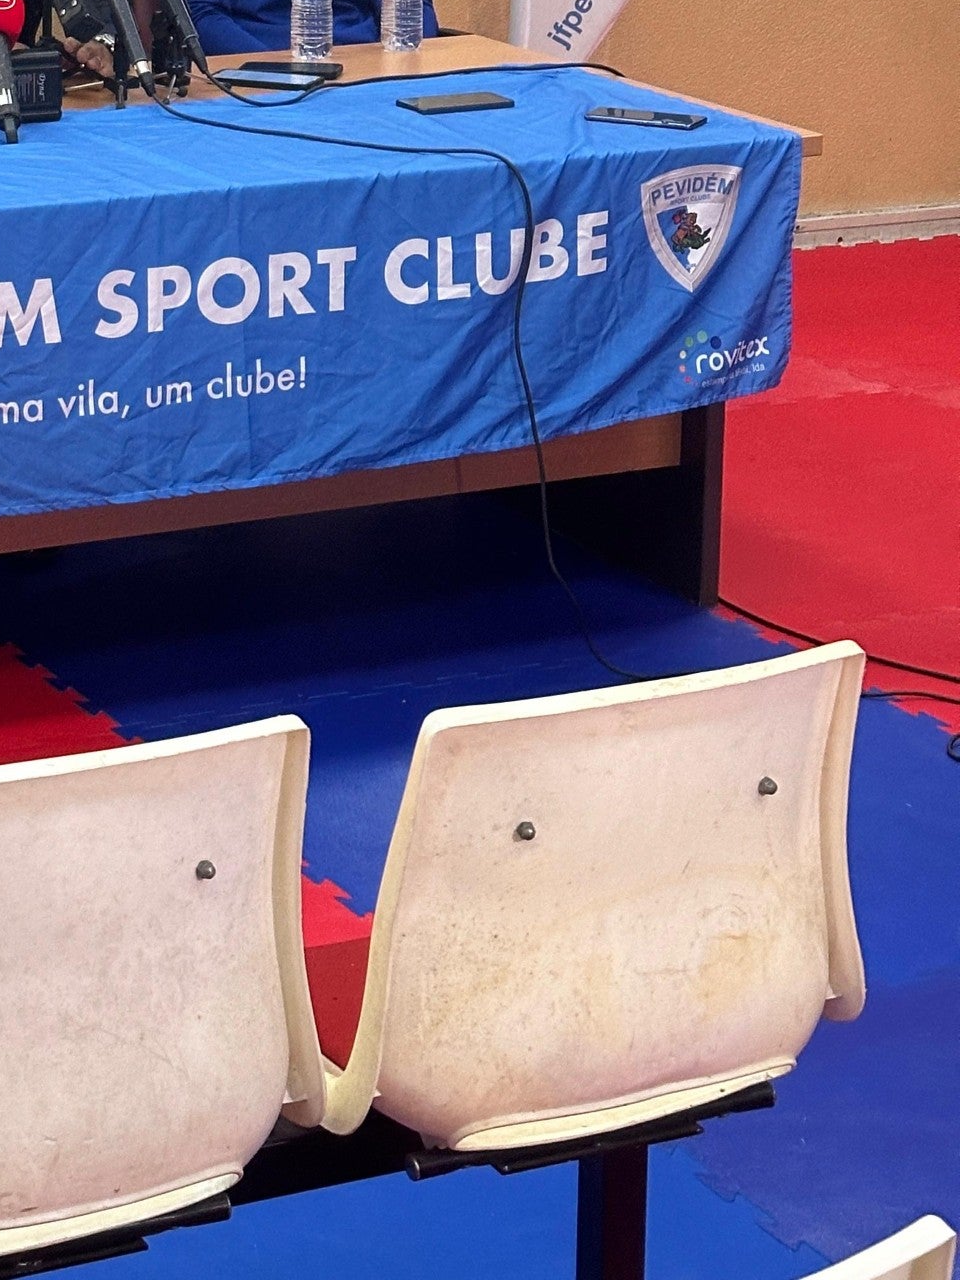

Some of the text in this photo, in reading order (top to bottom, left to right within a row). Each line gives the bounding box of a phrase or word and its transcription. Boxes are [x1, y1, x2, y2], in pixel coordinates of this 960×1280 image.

[651, 172, 735, 207] PEVIDÉM
[94, 246, 356, 339] SPORT
[384, 210, 609, 305] CLUBE
[695, 336, 770, 374] rovitex
[58, 379, 129, 419] vila,
[145, 380, 193, 408] um
[206, 356, 307, 399] clube!
